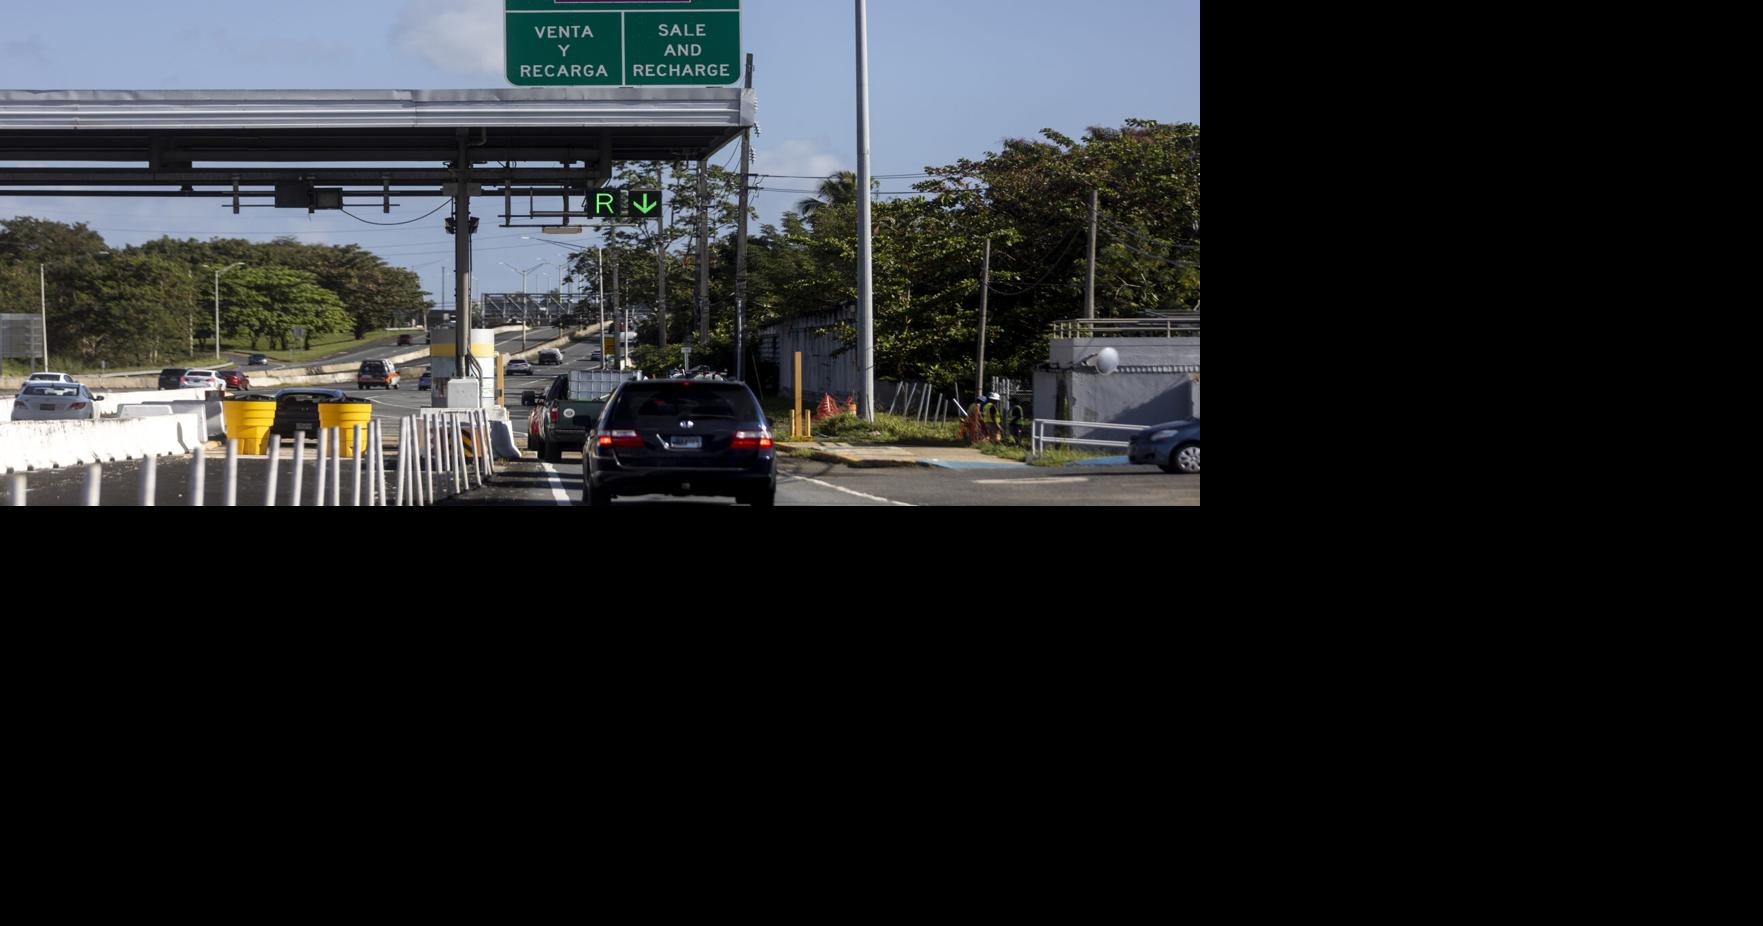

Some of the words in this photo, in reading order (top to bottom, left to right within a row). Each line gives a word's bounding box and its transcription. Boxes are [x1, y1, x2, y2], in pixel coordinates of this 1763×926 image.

[535, 25, 594, 39] VENTA
[658, 23, 706, 37] SALE
[558, 44, 570, 57] Y
[664, 43, 702, 57] AND
[520, 64, 608, 78] RECARGA
[633, 63, 730, 77] RECHARGE
[596, 192, 614, 214] R
